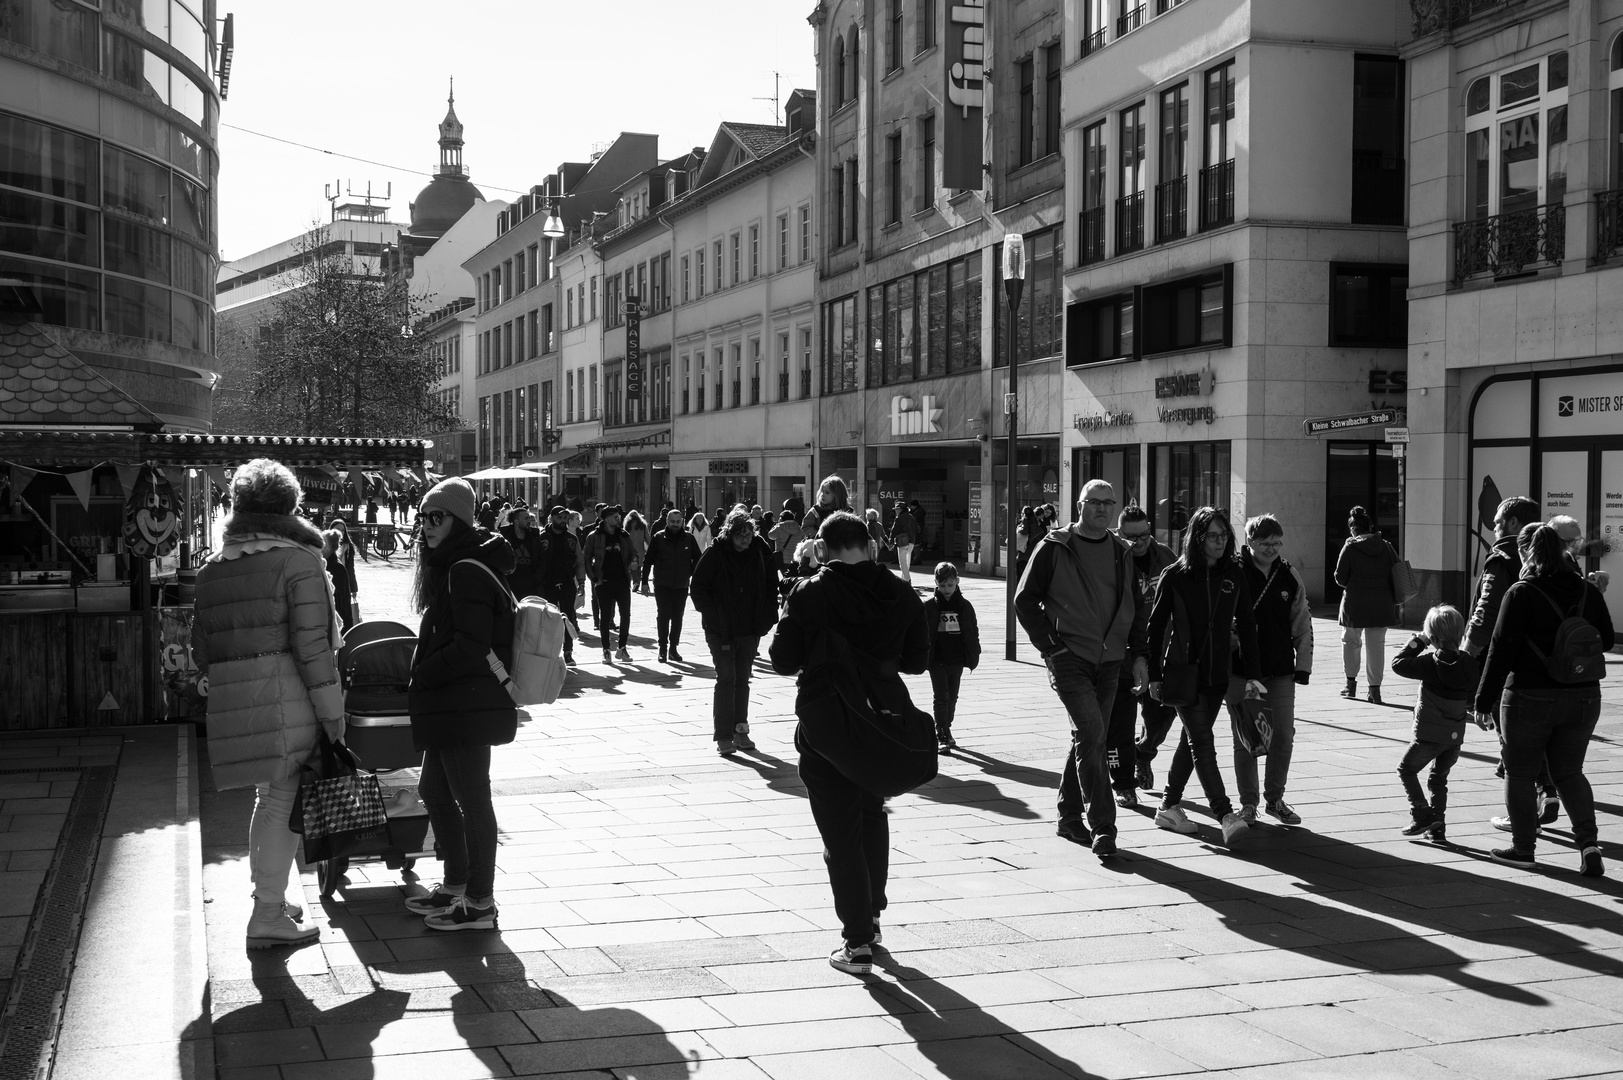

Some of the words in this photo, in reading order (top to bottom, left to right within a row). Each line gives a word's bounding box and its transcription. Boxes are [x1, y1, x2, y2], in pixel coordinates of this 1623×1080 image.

[628, 319, 639, 392] PASSAGE
[1155, 373, 1201, 399] ESWE
[888, 395, 943, 436] fink
[1156, 405, 1214, 426] Versorgung
[1578, 397, 1611, 413] MISTER
[1312, 421, 1329, 431] Kleine
[1330, 416, 1369, 428] Schwalbacher
[1371, 413, 1390, 424] Straße
[879, 491, 905, 499] SALE
[1043, 483, 1058, 493] SALE
[1107, 747, 1120, 769] THE
